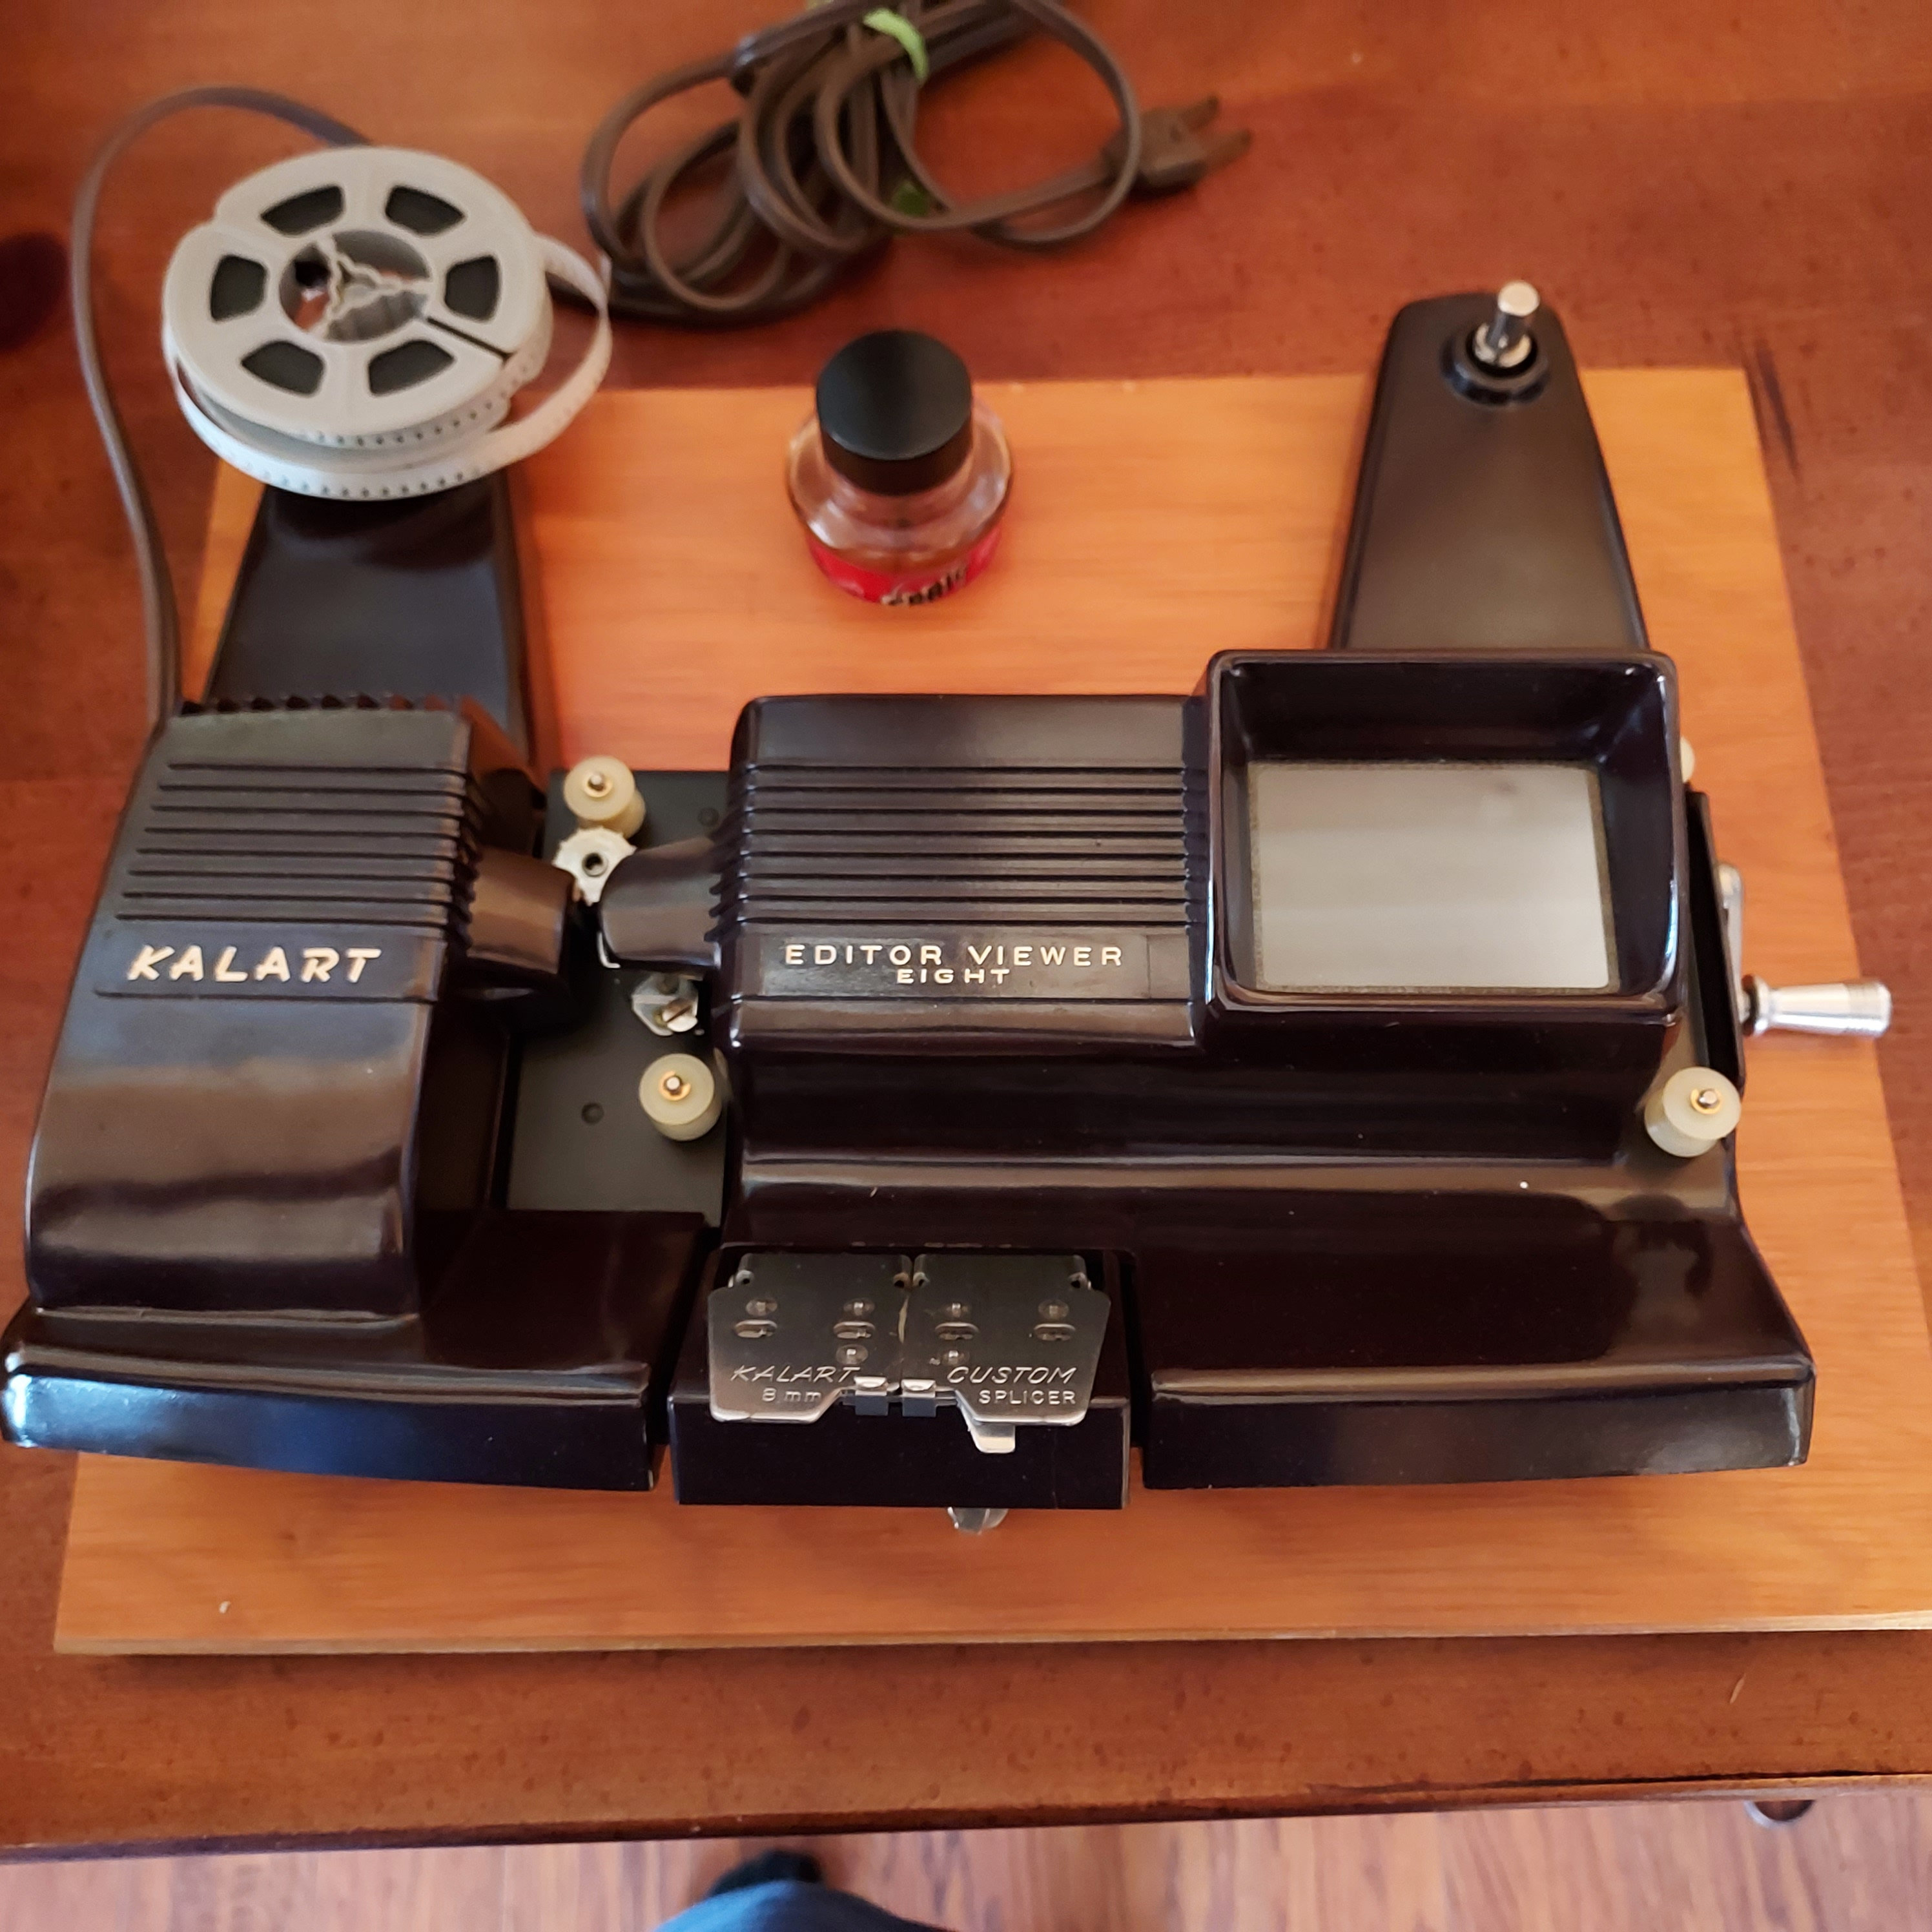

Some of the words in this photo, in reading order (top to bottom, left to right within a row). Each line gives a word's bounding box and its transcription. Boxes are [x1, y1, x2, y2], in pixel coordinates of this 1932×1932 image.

[127, 944, 382, 983] KALART
[785, 944, 942, 966] EDITOR
[967, 945, 1122, 967] VIEWER
[896, 968, 1010, 985] EIGHT
[730, 1364, 861, 1383] KALART
[947, 1366, 1077, 1384] CUSTOM
[978, 1389, 1076, 1405] SPLICER
